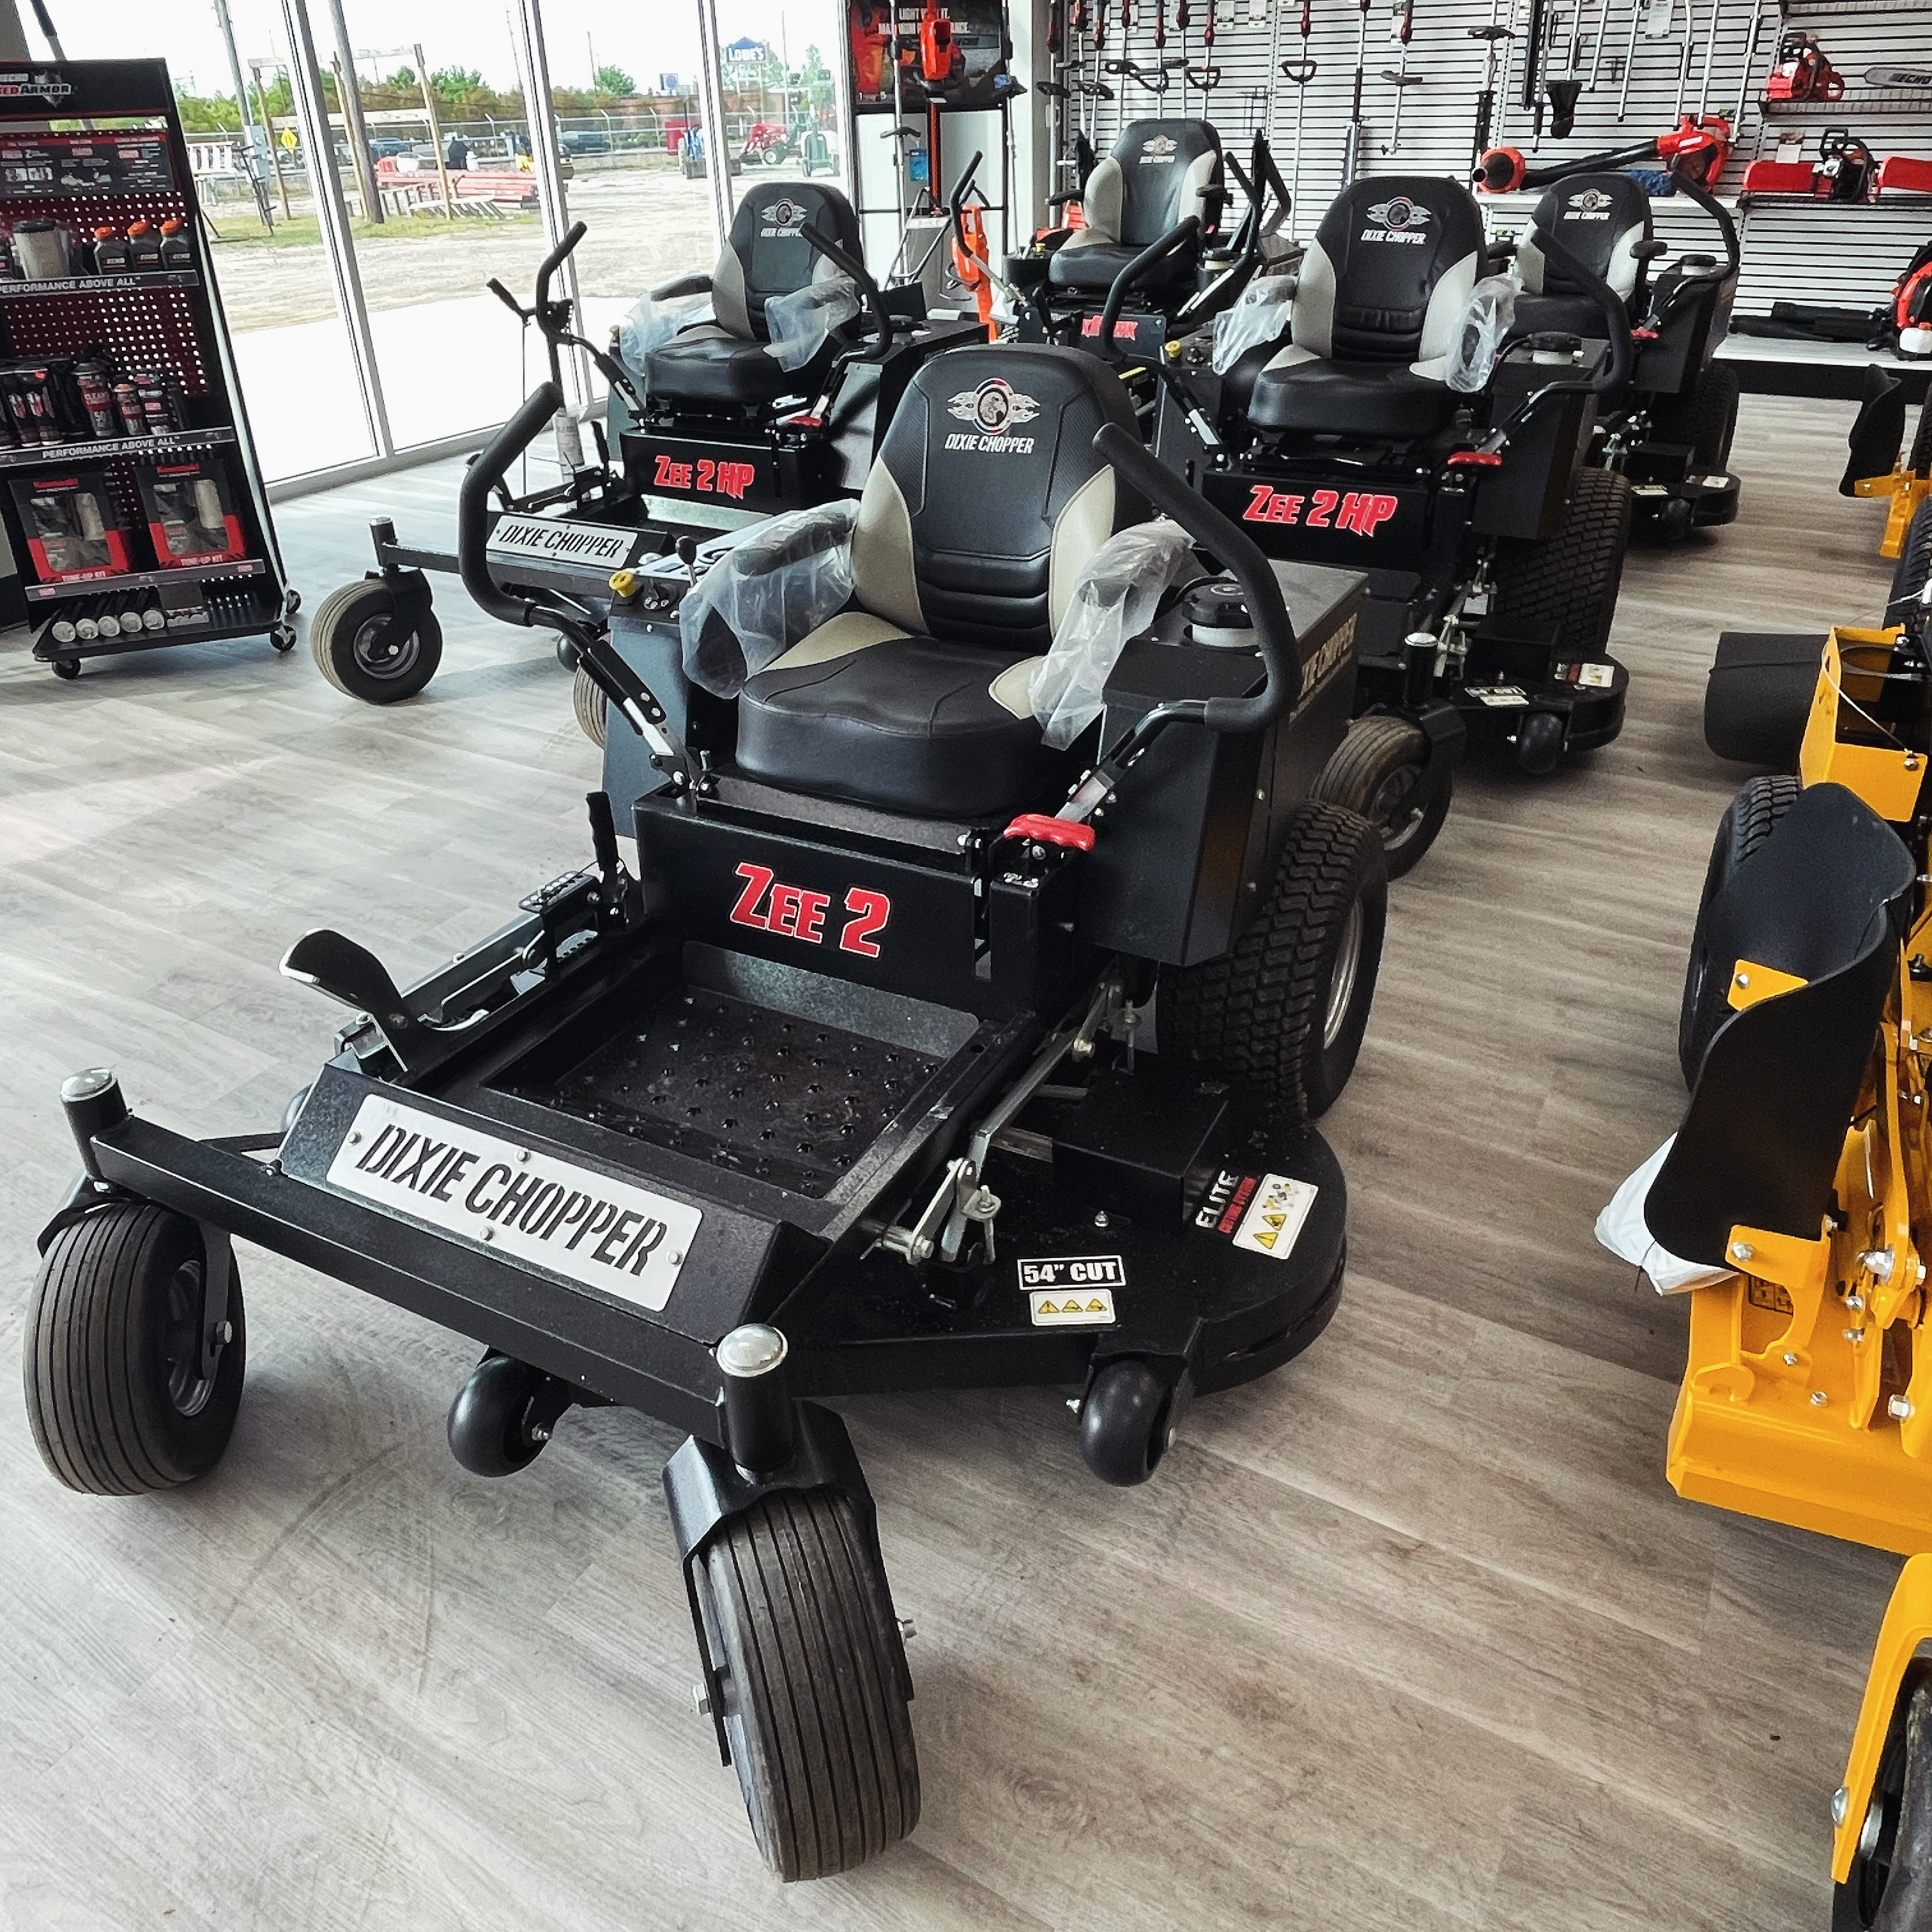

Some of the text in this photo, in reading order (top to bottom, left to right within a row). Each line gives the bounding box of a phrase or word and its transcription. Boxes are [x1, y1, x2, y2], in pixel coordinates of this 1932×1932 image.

[728, 47, 763, 61] LOWE'S
[79, 277, 114, 288] ABOVE
[42, 443, 119, 459] PERFORMANCE
[122, 440, 155, 450] ABOVE
[944, 433, 1035, 454] DIXIE CHOPPER
[654, 455, 755, 500] ZEE 2 HP
[1243, 484, 1398, 538] ZEE 2 HP
[498, 525, 624, 558] DIXIE CHOPPER
[730, 862, 891, 958] ZEE 2
[355, 1123, 668, 1276] DIXIE CHOPPER
[1195, 1169, 1239, 1229] ELITE
[1023, 1261, 1117, 1284] 54" CUT
